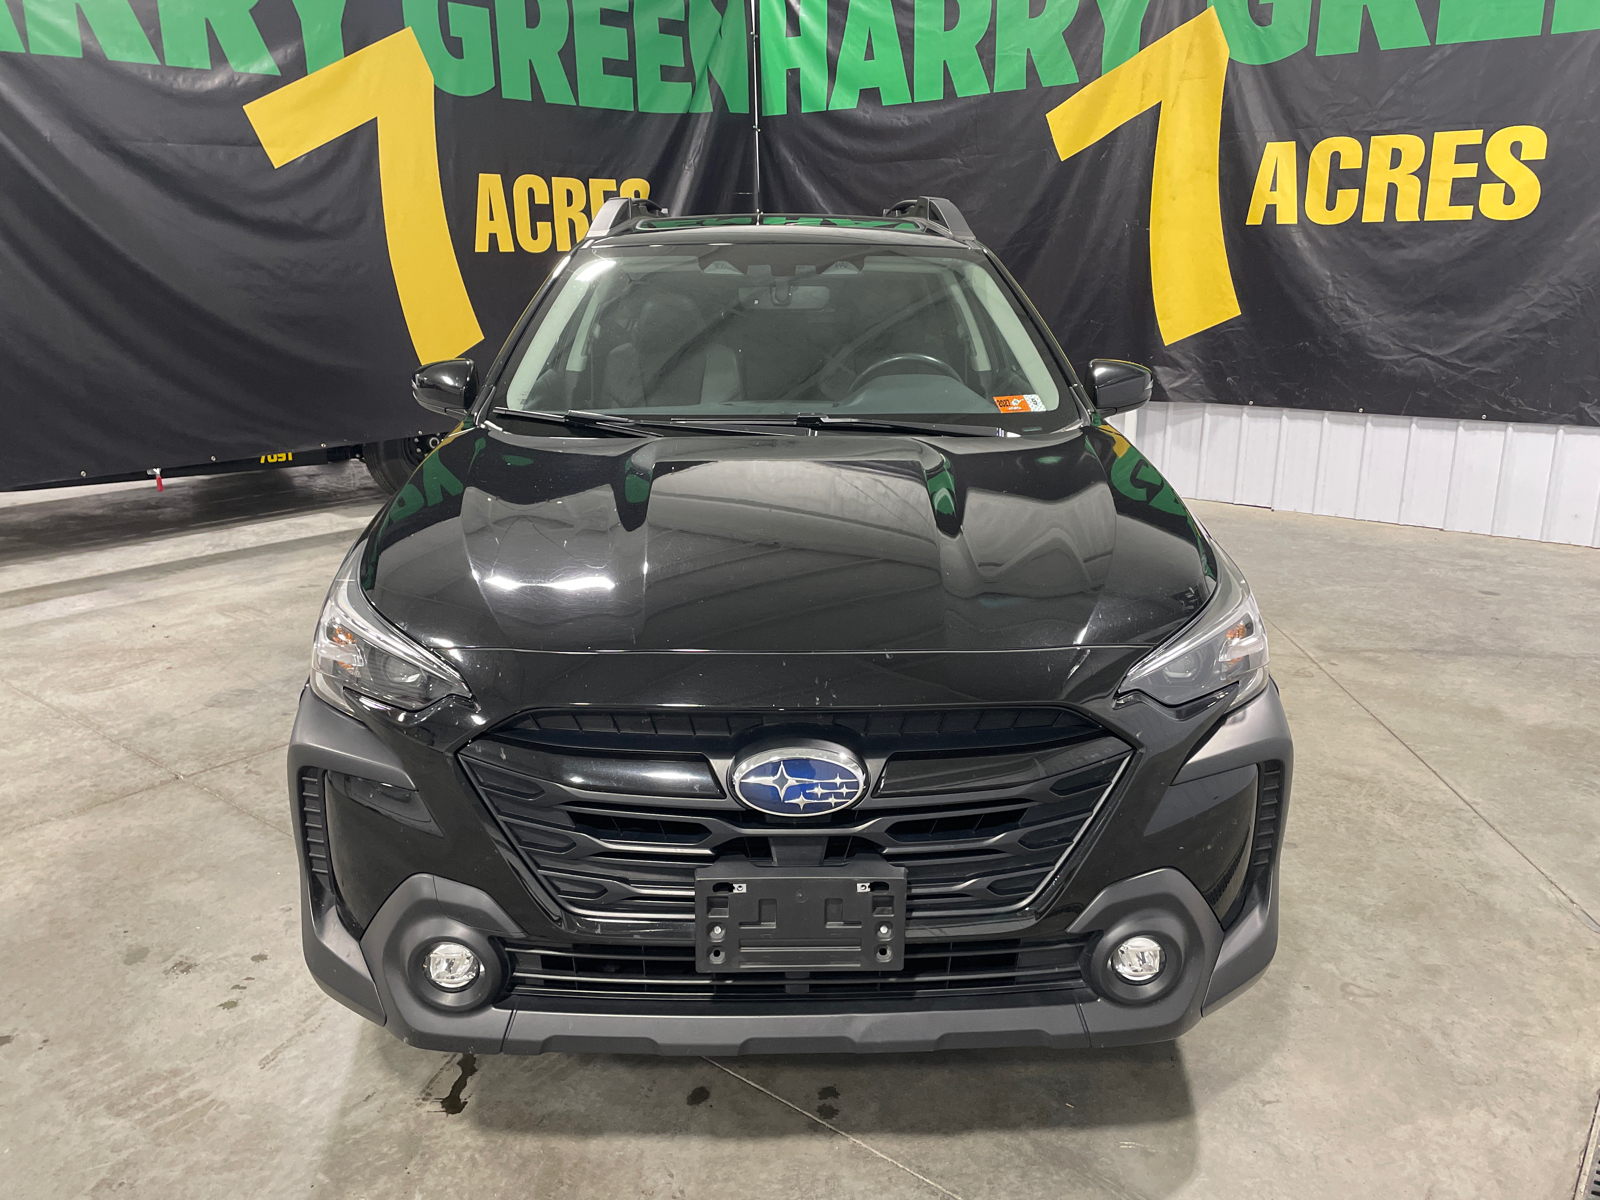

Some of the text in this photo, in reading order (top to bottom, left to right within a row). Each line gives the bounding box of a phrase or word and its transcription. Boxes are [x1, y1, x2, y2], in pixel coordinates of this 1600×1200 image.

[403, 0, 749, 114] GREEN
[759, 0, 1149, 116] HARRY
[243, 27, 650, 366] 7 ACR
[1046, 6, 1548, 346] 7 ACRES
